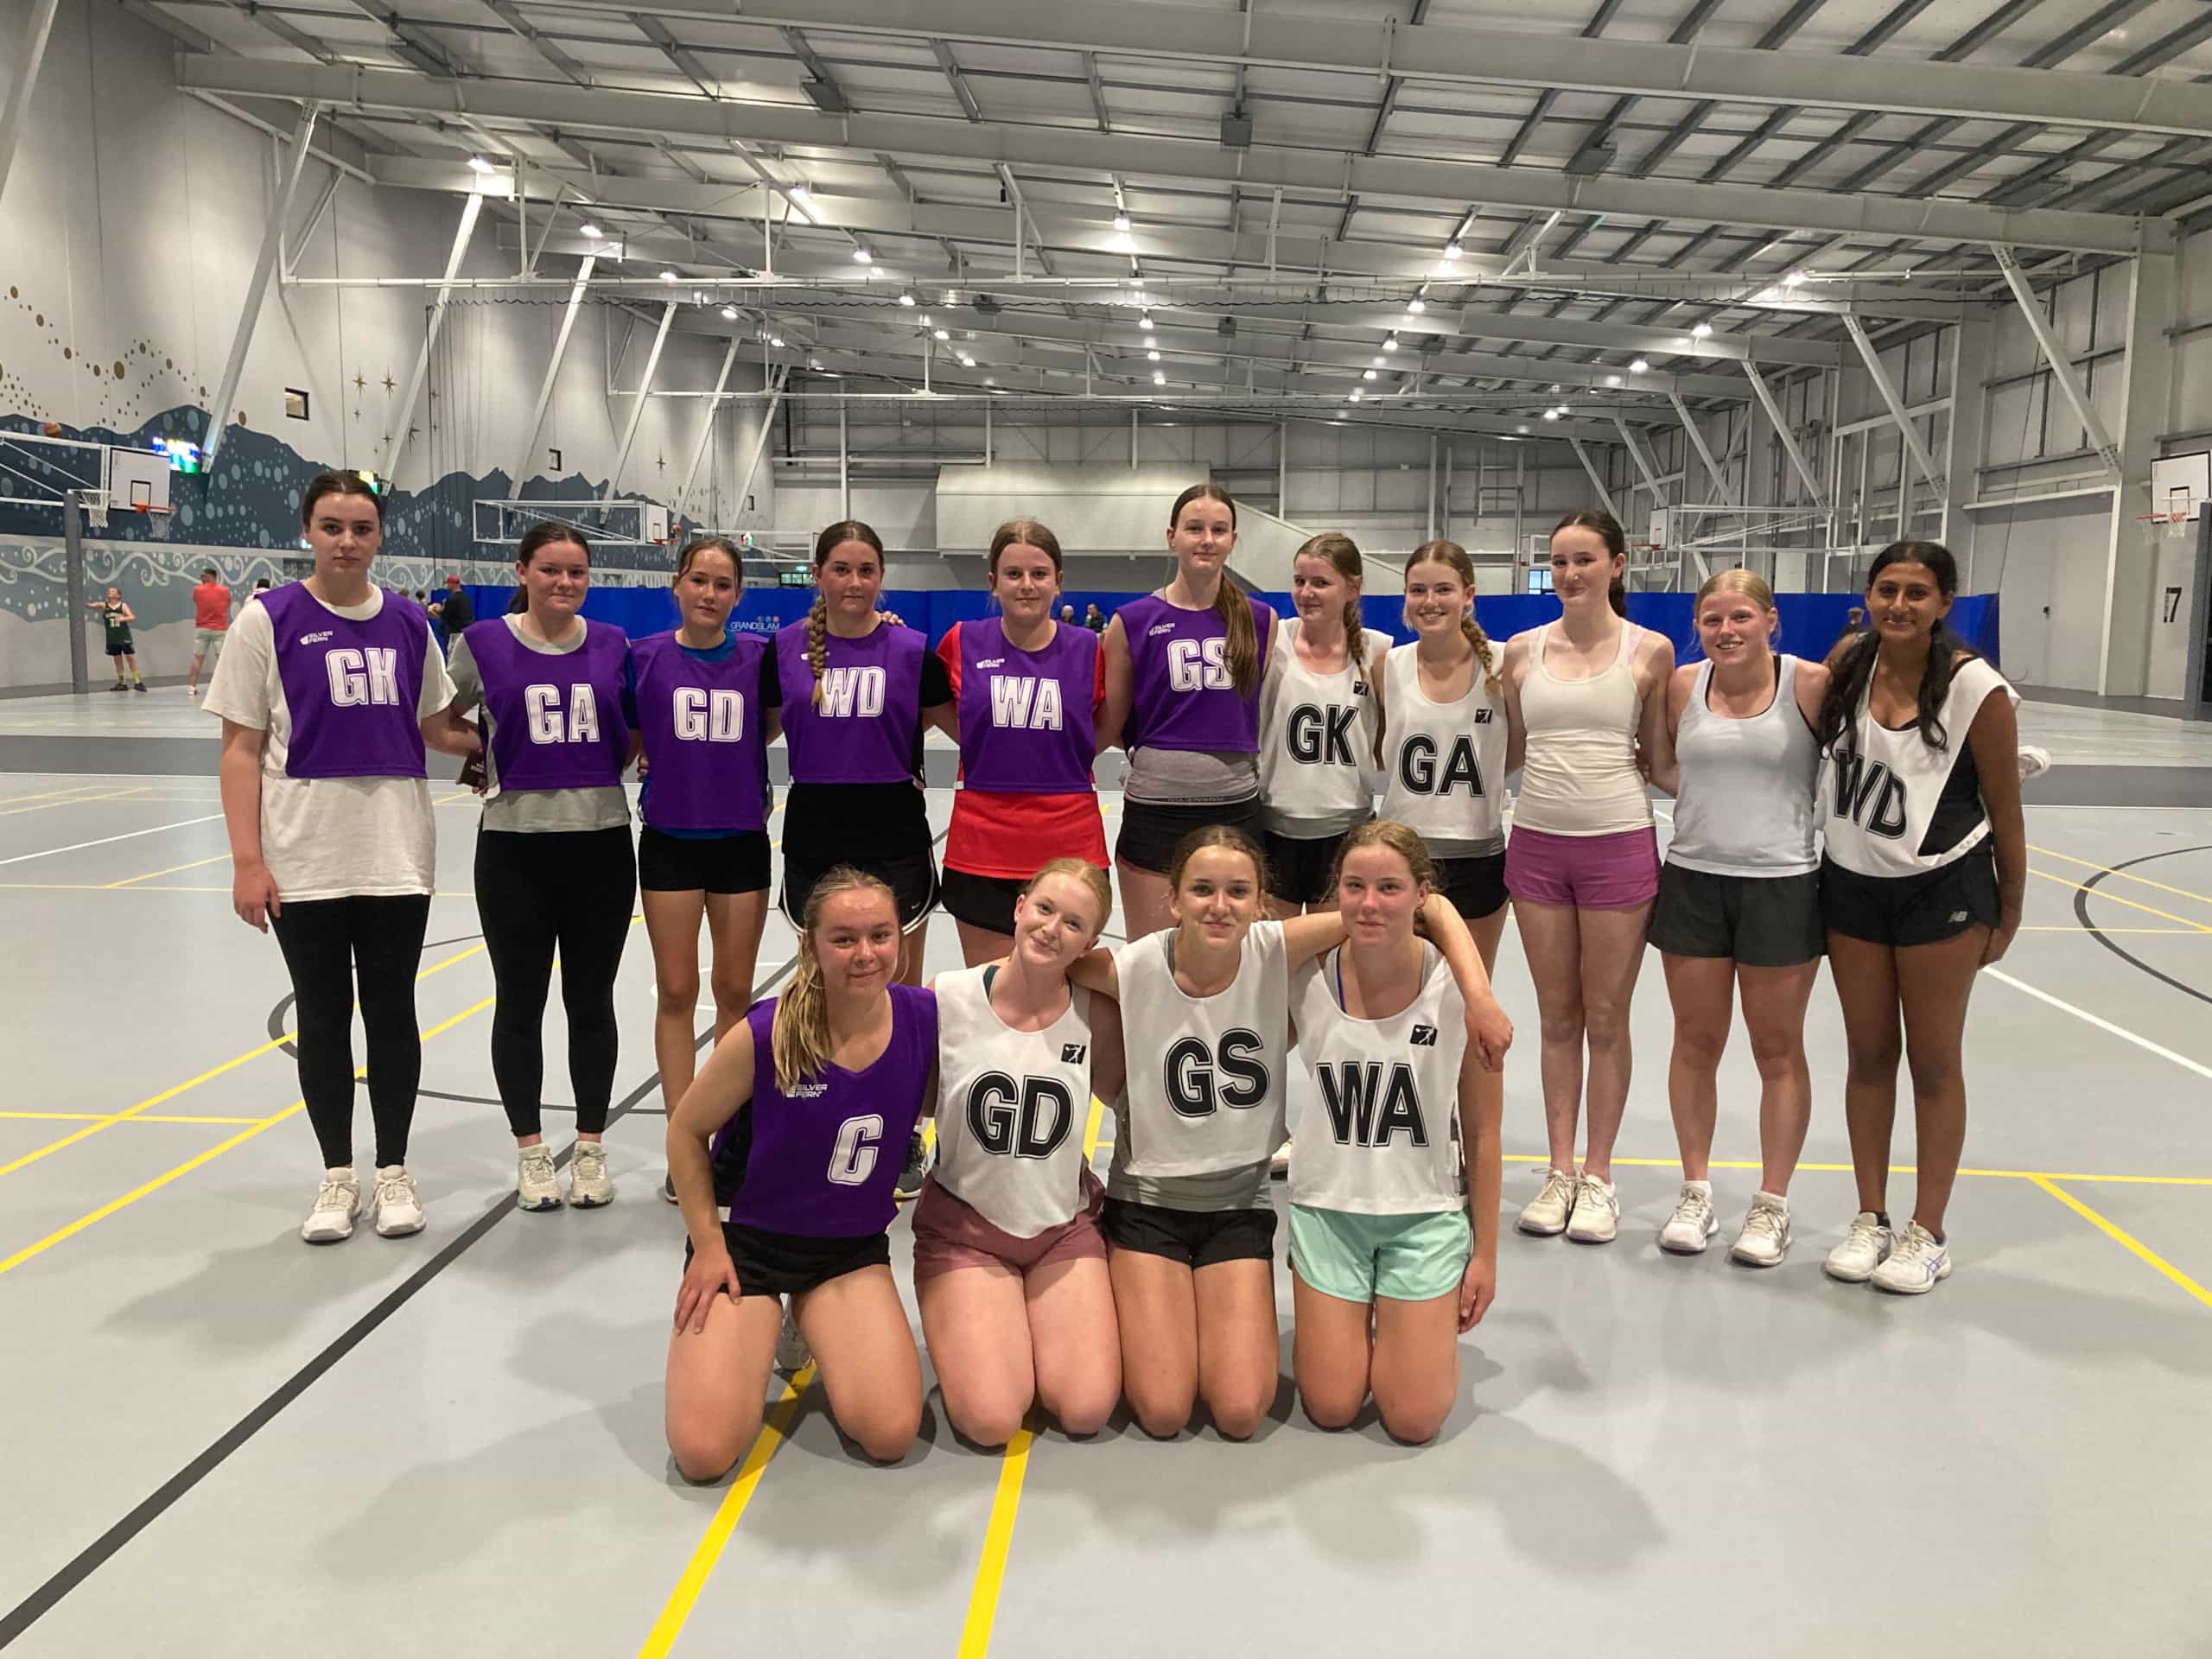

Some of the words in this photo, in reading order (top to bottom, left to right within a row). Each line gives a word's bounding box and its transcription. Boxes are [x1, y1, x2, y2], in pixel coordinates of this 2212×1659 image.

[325, 647, 399, 707] GK
[818, 666, 886, 717] WD
[1167, 637, 1237, 691] GS
[524, 683, 601, 744] GA
[673, 687, 744, 742] GD
[990, 675, 1063, 731] WA
[1286, 703, 1359, 766] GK
[1399, 734, 1485, 798] GA
[1834, 748, 1907, 840] WD
[1164, 1027, 1270, 1117] GS
[967, 1071, 1074, 1160] GD
[1316, 1061, 1429, 1147] WA
[827, 1114, 884, 1185] C
